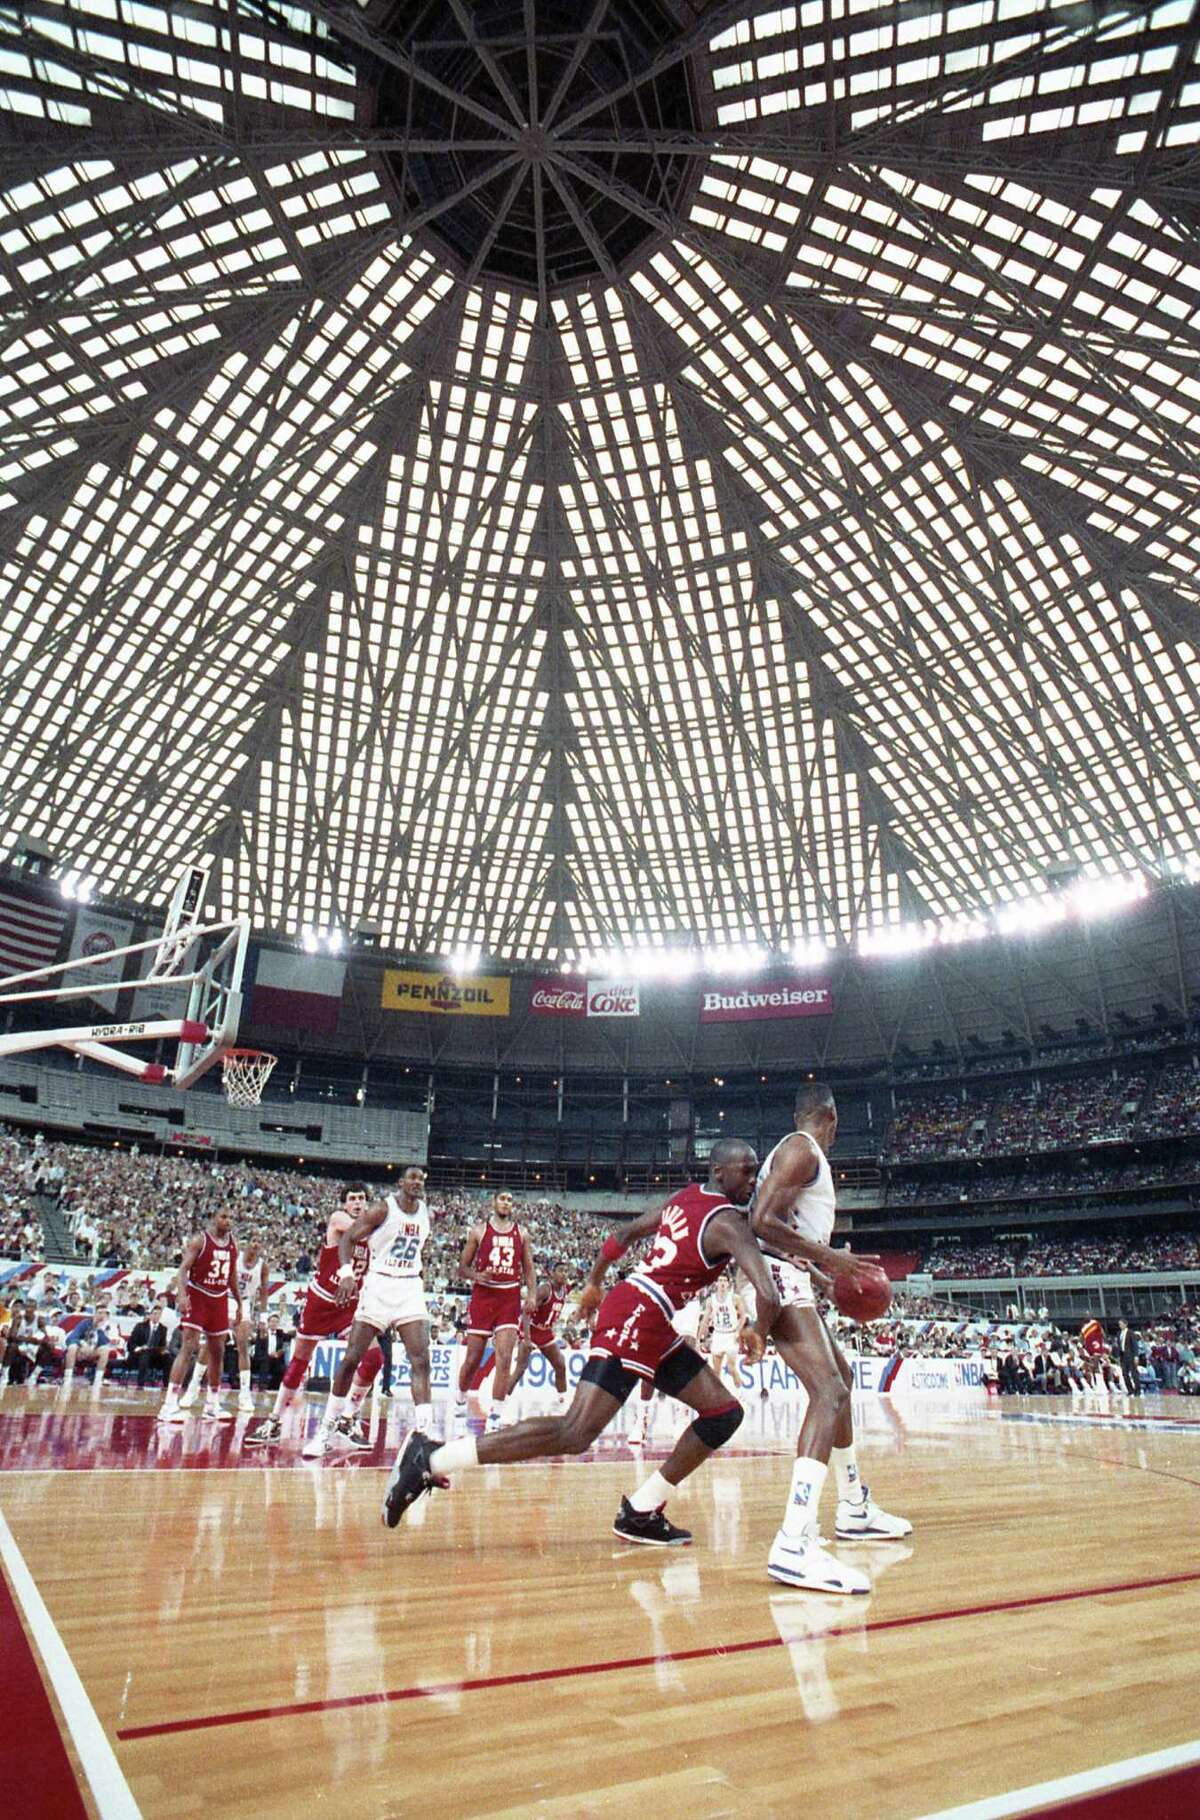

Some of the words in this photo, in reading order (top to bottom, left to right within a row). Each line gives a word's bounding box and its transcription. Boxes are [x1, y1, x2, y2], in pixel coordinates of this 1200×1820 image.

[397, 983, 495, 1003] PENNZOIL
[590, 992, 636, 1013] Coke
[703, 987, 828, 1011] Budweiser
[390, 1236, 420, 1260] 26
[488, 1246, 515, 1268] 43
[617, 1303, 646, 1347] EAST
[716, 1312, 730, 1324] 12
